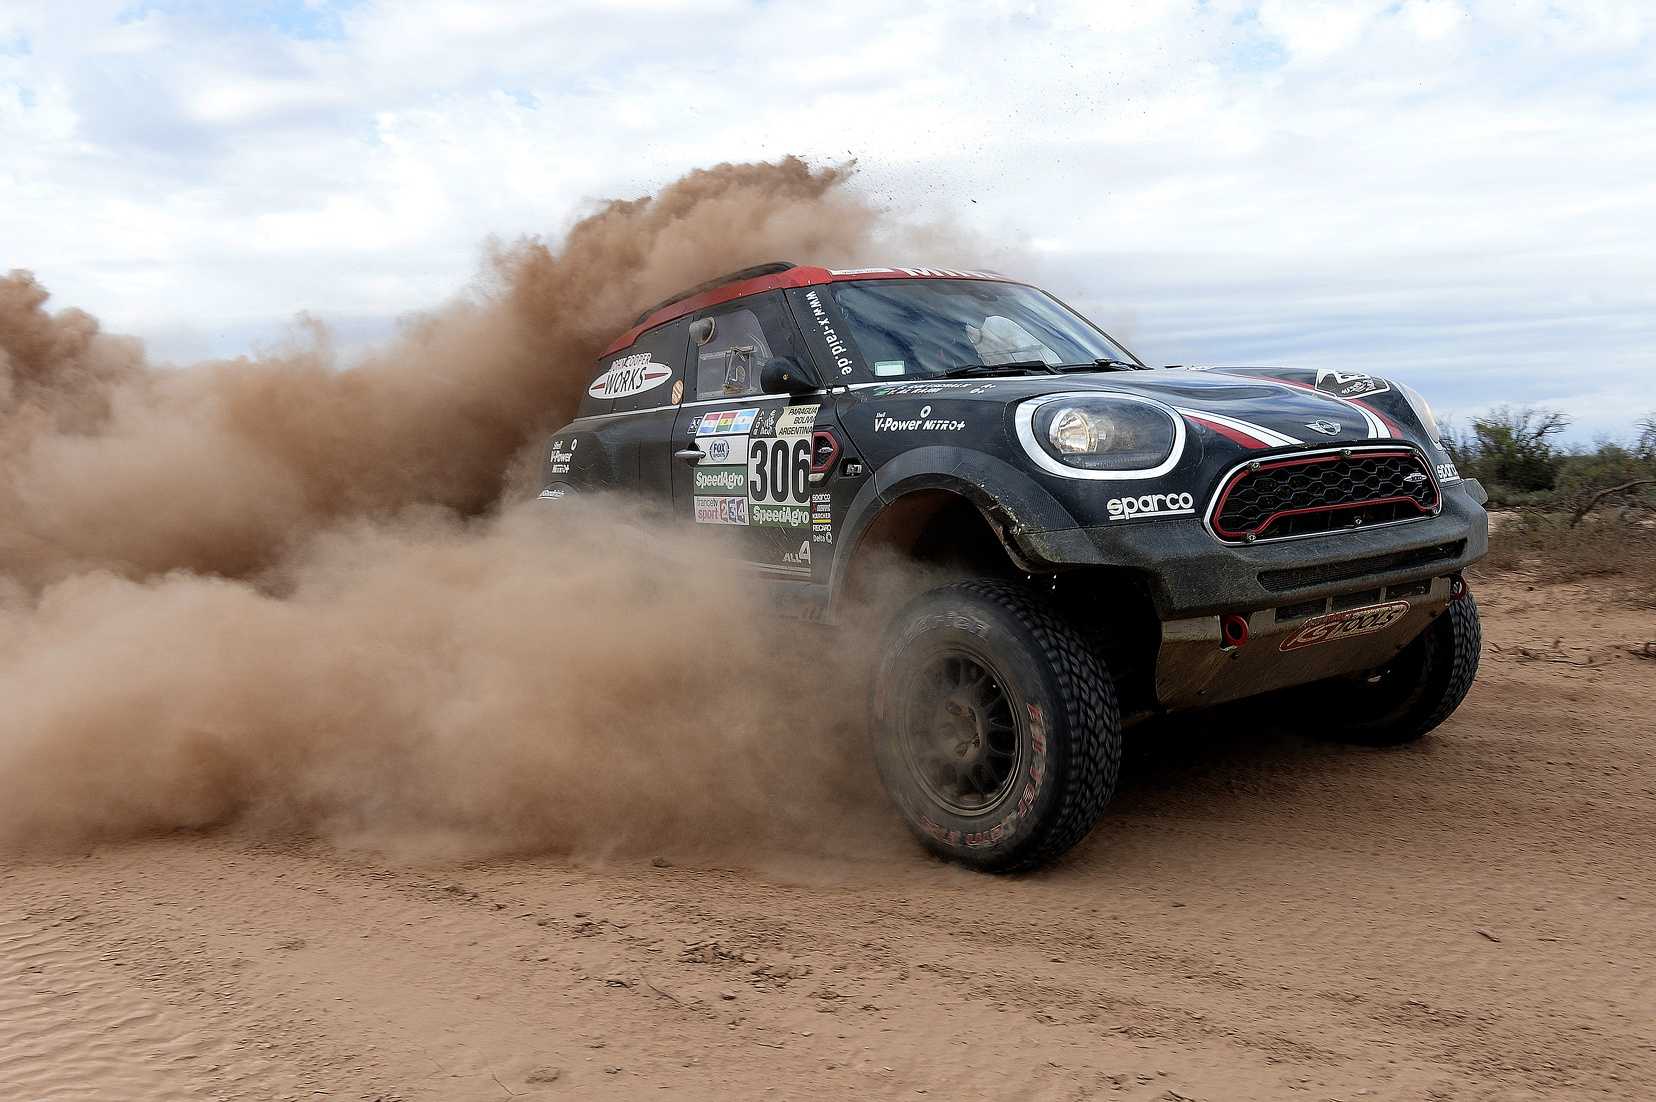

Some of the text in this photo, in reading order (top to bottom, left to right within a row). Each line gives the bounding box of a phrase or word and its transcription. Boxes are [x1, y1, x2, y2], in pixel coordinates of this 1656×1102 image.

[806, 290, 853, 376] www.x-raid.de
[604, 366, 647, 395] WORKS
[874, 417, 922, 432] V-Power
[713, 442, 726, 454] FOX
[696, 471, 744, 489] SpeedAgro
[750, 439, 811, 503] 306
[753, 506, 810, 527] SpeedAgro
[1107, 492, 1194, 520] sparco
